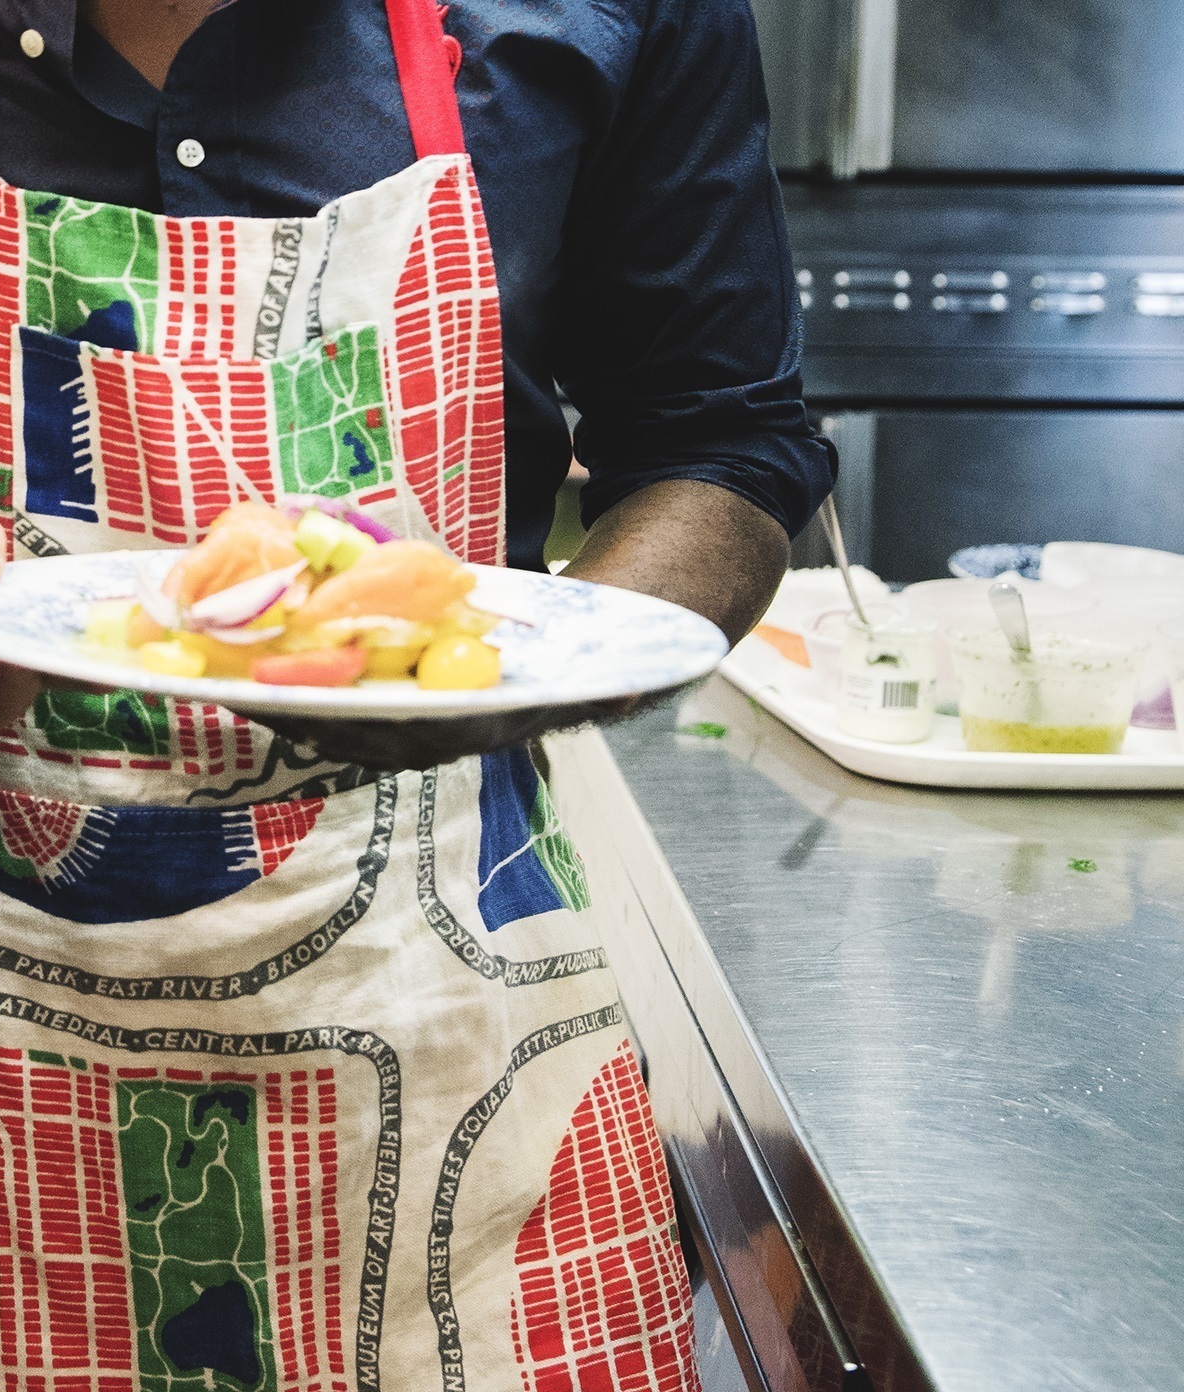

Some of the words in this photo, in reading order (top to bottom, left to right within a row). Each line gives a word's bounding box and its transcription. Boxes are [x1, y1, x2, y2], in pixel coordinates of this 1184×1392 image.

[268, 239, 299, 294] ART
[259, 293, 286, 328] OF
[266, 881, 375, 983] BROOKLYN
[15, 957, 80, 988] PARK
[95, 978, 153, 997] EAST
[160, 976, 242, 999] RIVER
[504, 958, 552, 985] HENRY
[145, 1031, 276, 1055] CENTRAL
[284, 1028, 350, 1052] PARK
[558, 1011, 604, 1040] PUBLIC
[357, 1033, 399, 1126] BASEBALL
[373, 1129, 400, 1201] FIELDS
[433, 1150, 464, 1226] TIMES
[458, 1069, 513, 1150] SQUARE
[368, 1197, 393, 1249] ART
[366, 1248, 388, 1277] OF
[429, 1231, 451, 1305] STREET
[358, 1283, 383, 1388] MUSEUM
